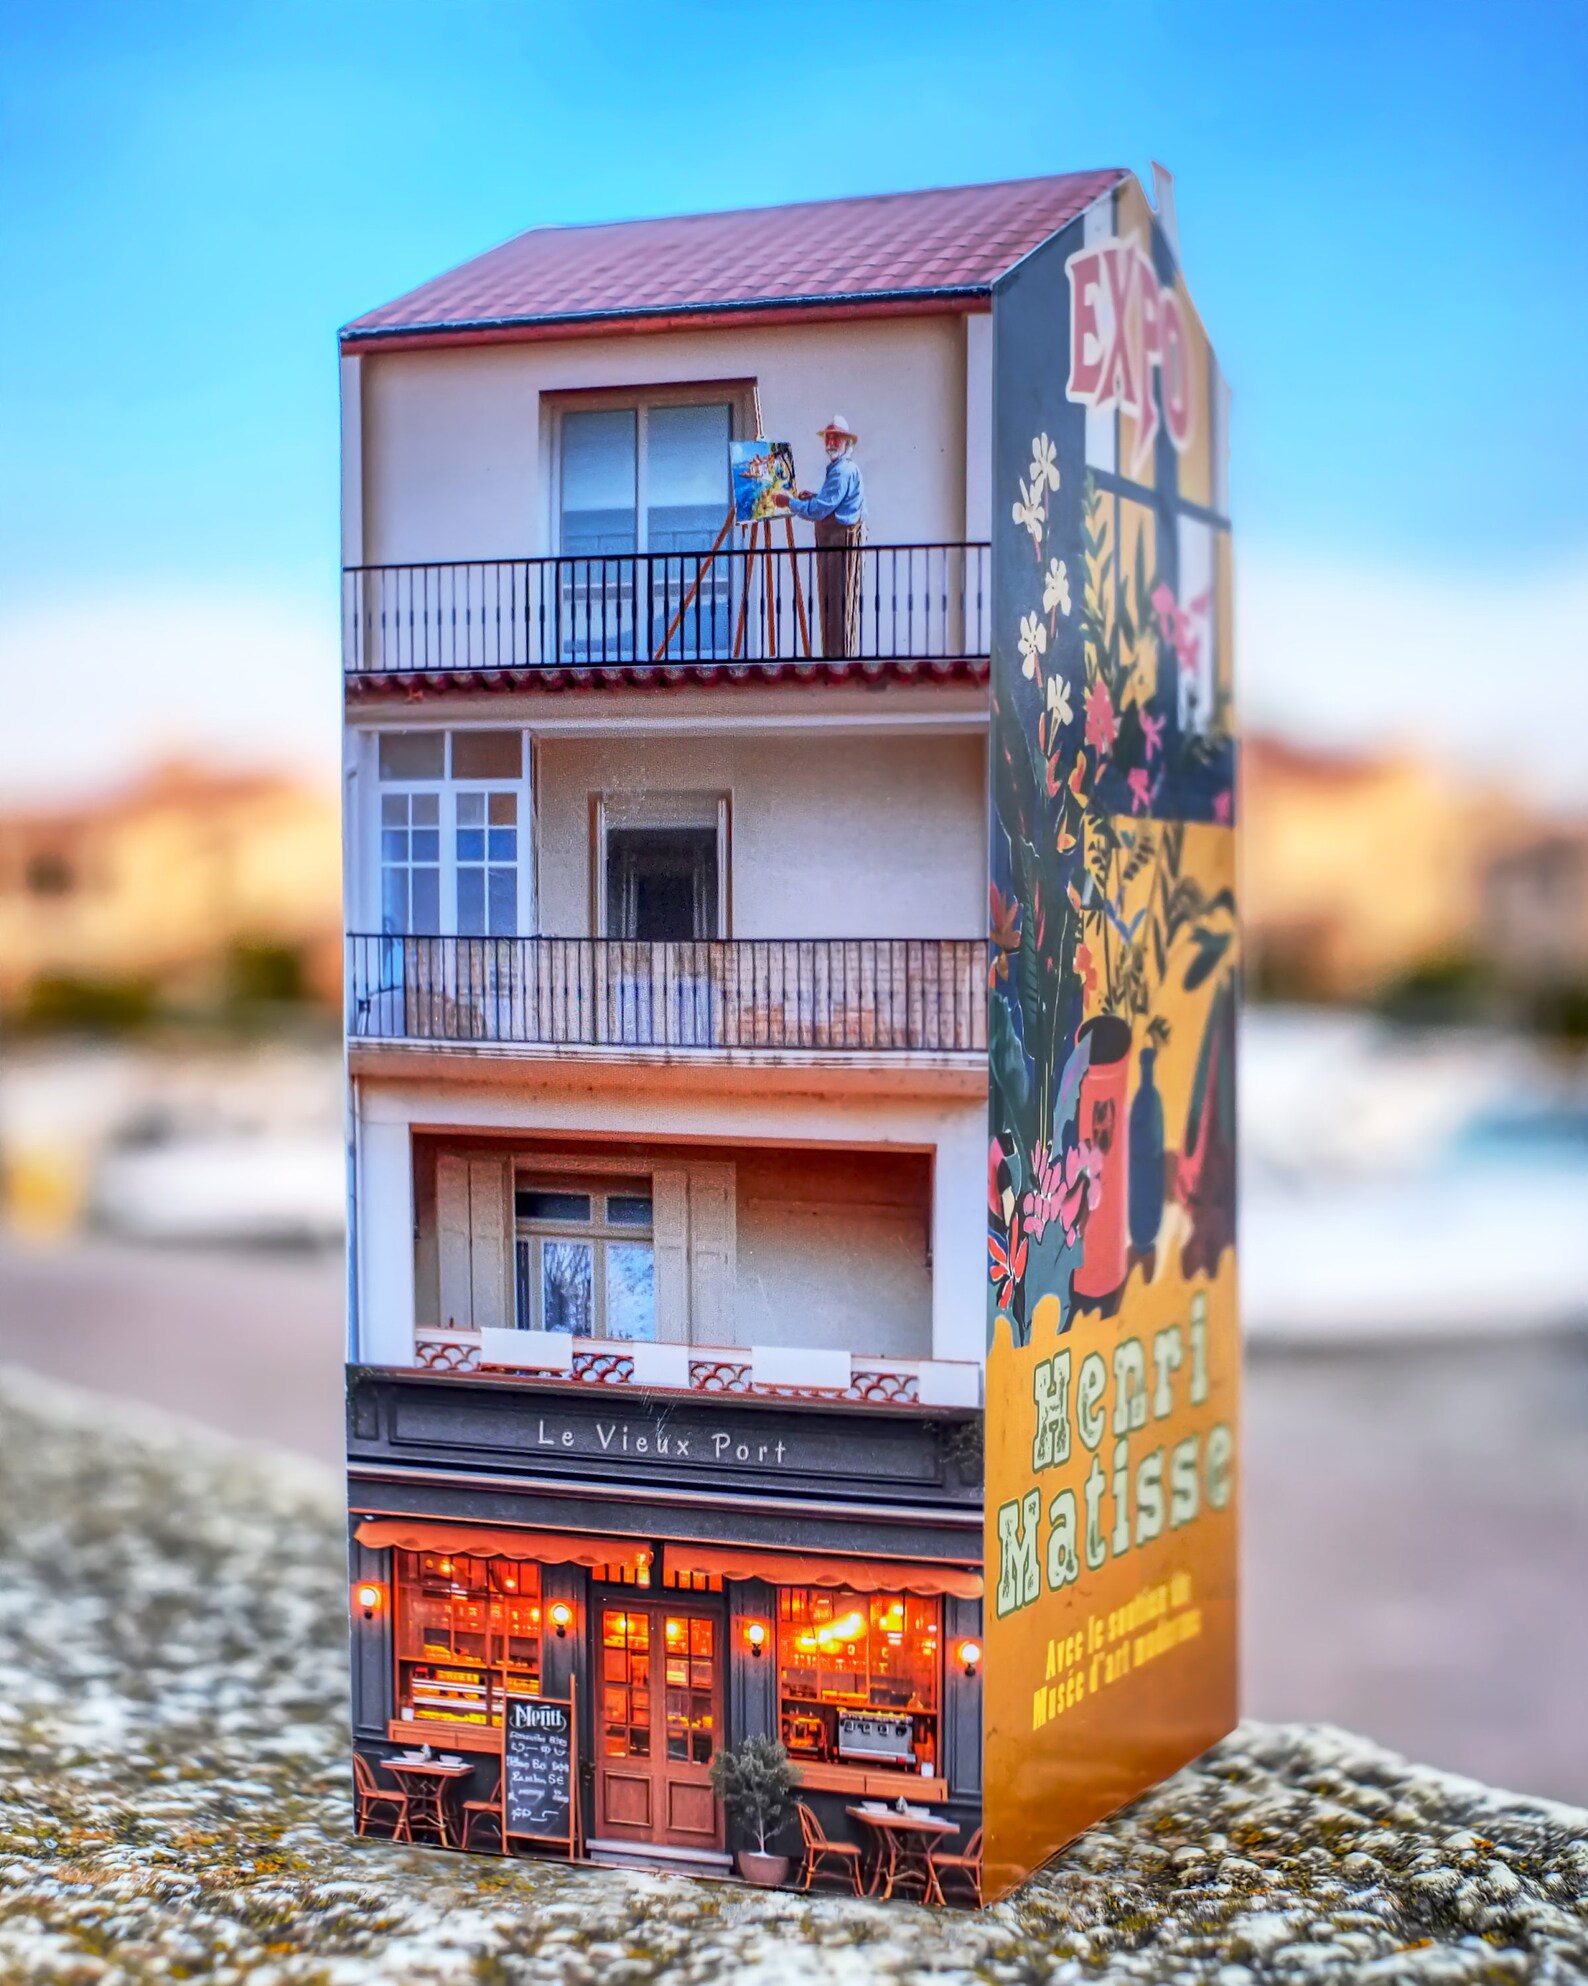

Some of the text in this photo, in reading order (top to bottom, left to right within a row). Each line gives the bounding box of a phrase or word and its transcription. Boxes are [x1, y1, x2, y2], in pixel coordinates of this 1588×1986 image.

[1066, 232, 1197, 476] EXPO
[1032, 1291, 1209, 1473] Henri
[538, 1419, 786, 1464] Le Vieux Port
[996, 1424, 1233, 1621] Matisse
[1045, 1630, 1084, 1681] Avec
[1087, 1614, 1104, 1655] le
[514, 1703, 562, 1727] Menu
[1032, 1667, 1085, 1731] Musée
